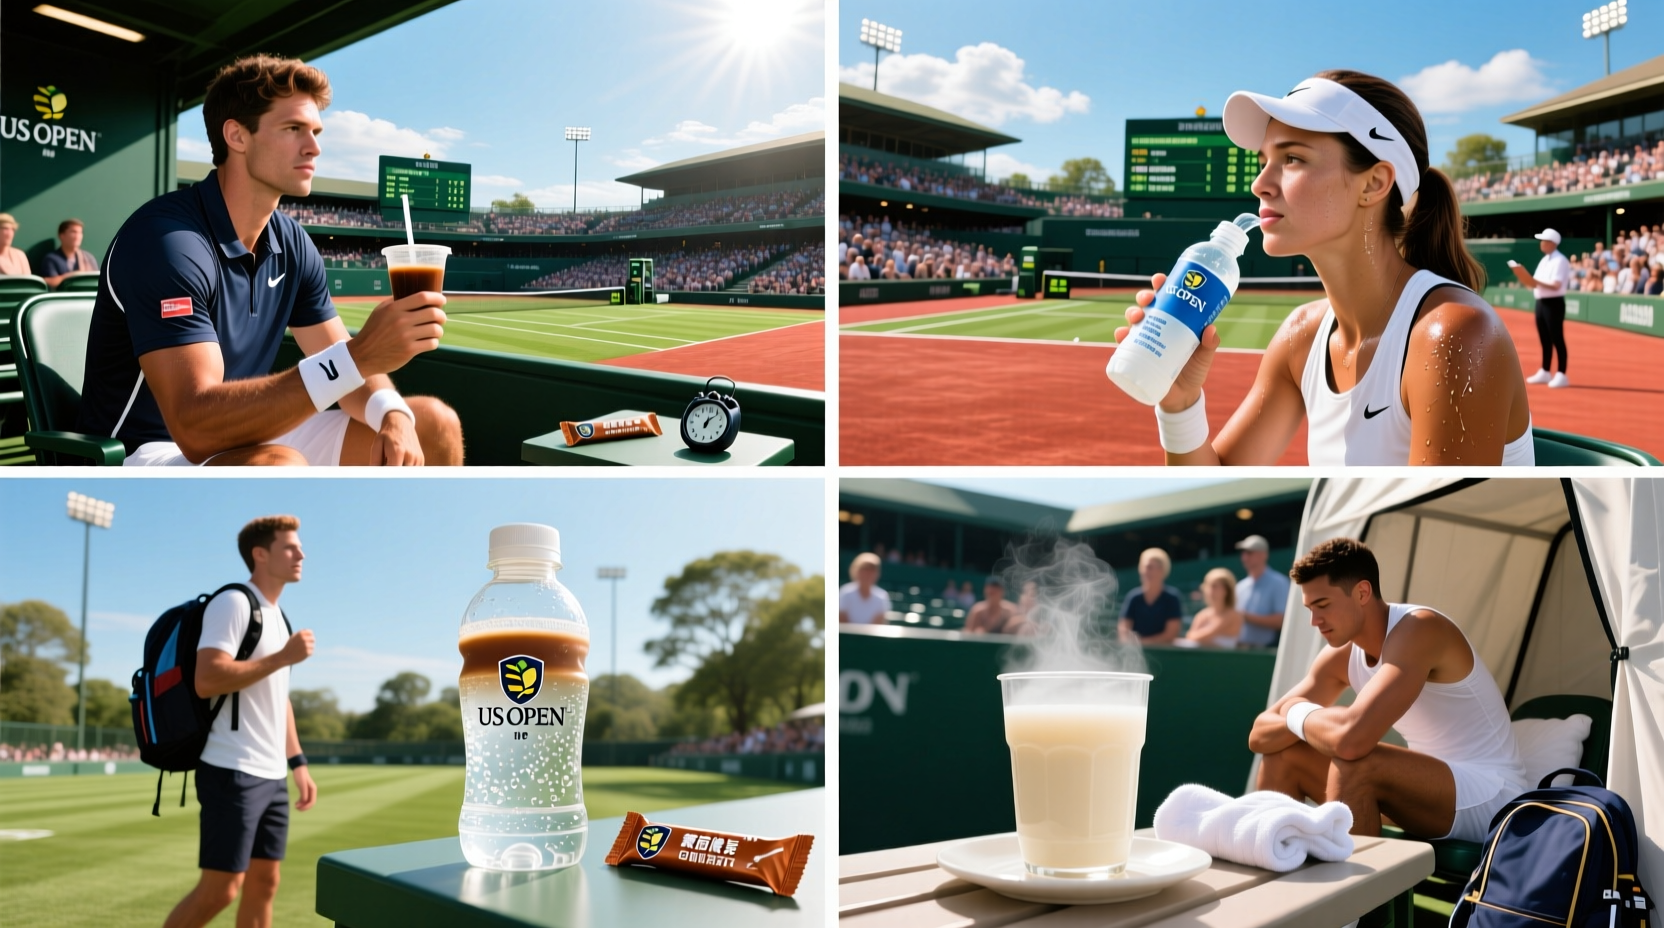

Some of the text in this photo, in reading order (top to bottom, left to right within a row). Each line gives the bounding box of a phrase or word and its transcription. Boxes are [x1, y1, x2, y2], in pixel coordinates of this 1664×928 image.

[0, 115, 96, 153] US OPEN
[478, 707, 565, 726] US OPEN
